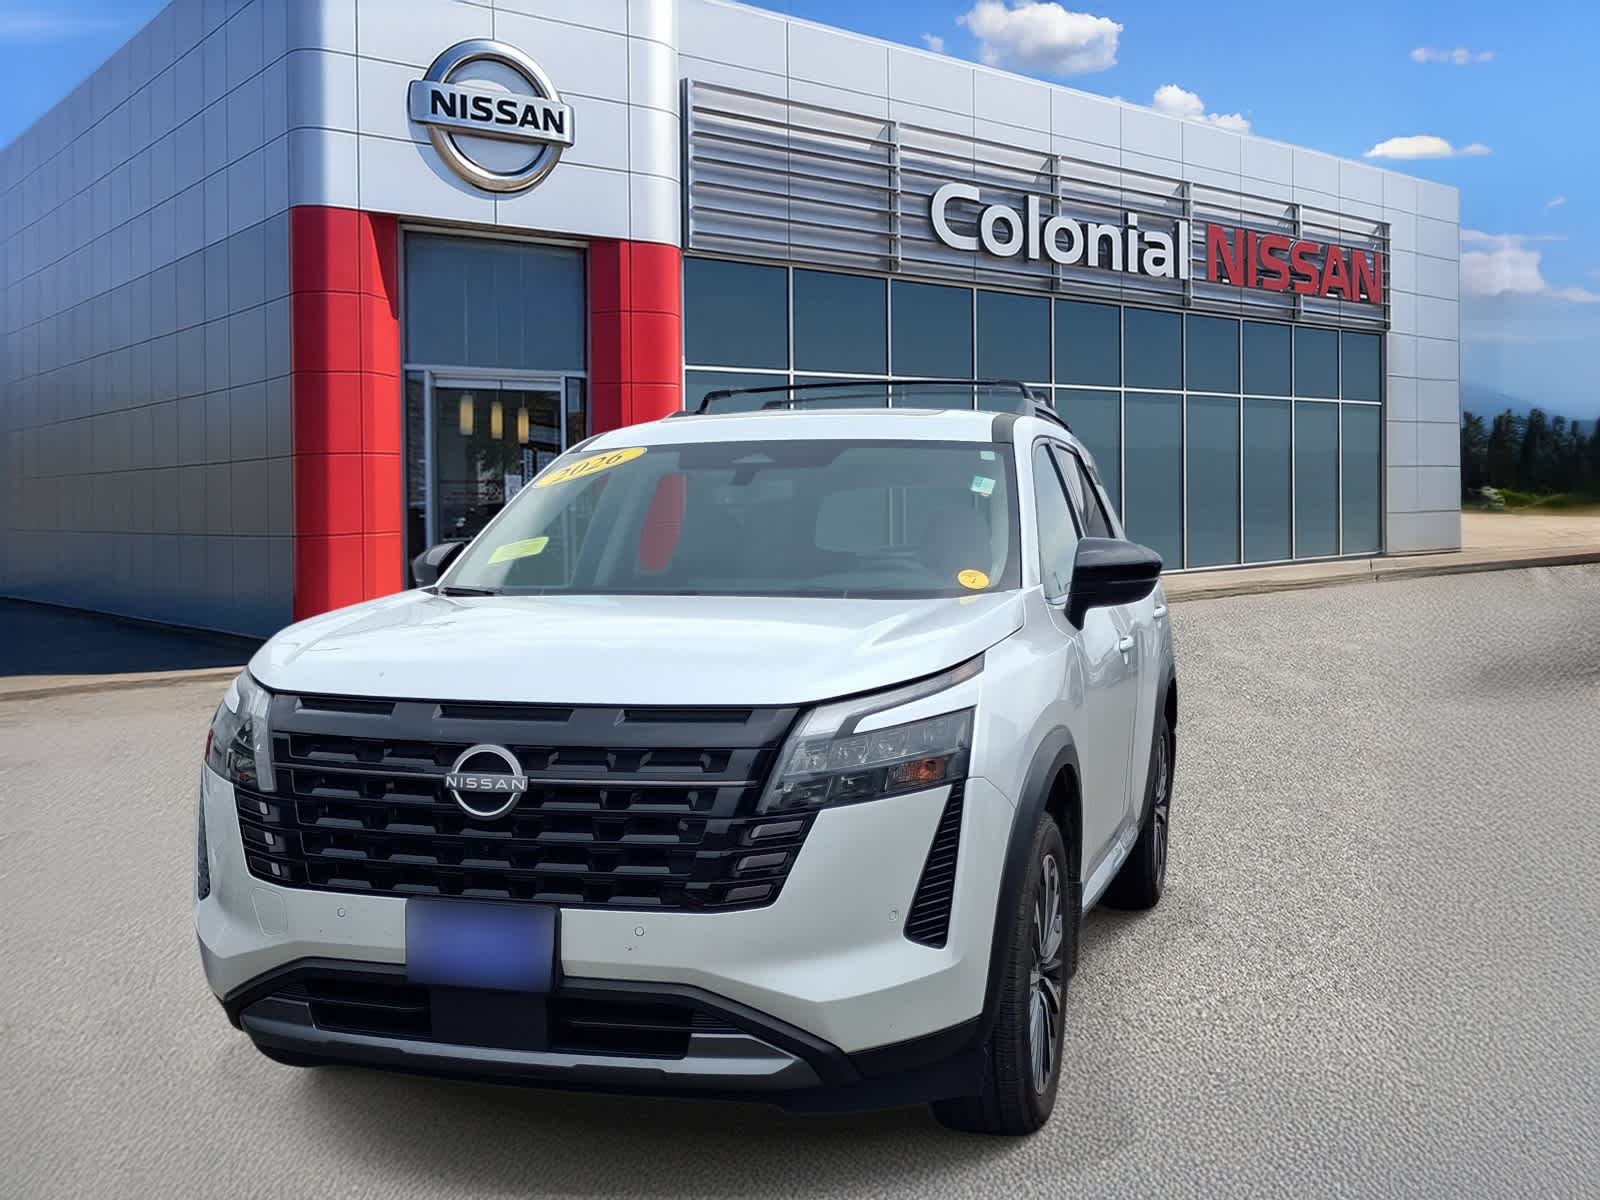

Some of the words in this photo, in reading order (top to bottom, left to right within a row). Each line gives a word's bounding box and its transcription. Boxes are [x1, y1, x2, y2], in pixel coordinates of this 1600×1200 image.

[430, 88, 564, 134] NISSAN
[931, 182, 1189, 280] Colonial
[1207, 224, 1382, 304] NISSAN
[555, 453, 622, 480] 2026
[446, 775, 525, 790] NISSAN
